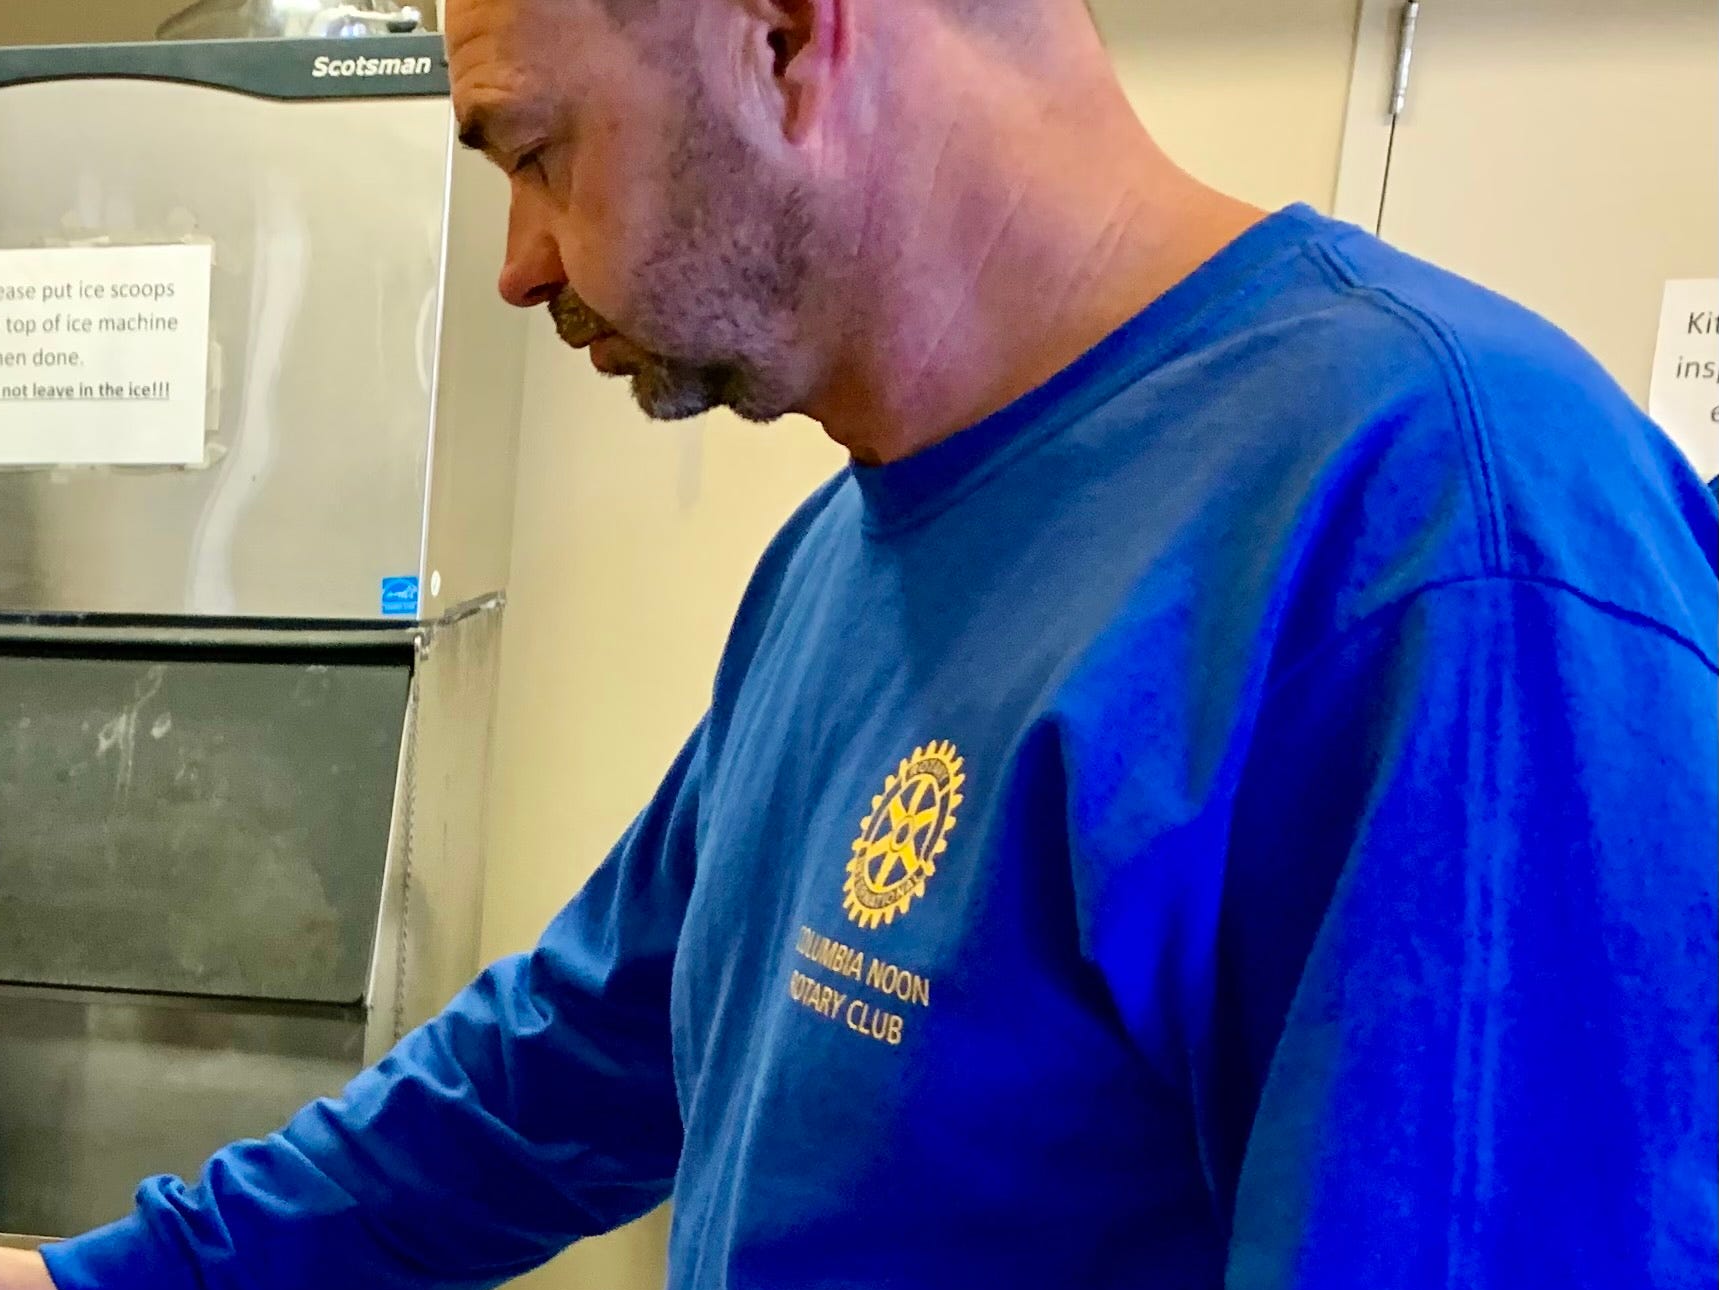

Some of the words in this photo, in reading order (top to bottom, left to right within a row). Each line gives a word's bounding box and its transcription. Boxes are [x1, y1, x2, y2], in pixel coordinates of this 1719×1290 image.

[311, 56, 432, 77] Scotsman
[42, 282, 72, 302] put
[79, 281, 104, 299] ice
[111, 281, 175, 302] scoops
[6, 316, 37, 336] top
[42, 314, 61, 333] of
[67, 314, 92, 332] ice
[98, 313, 178, 332] machine
[32, 348, 85, 366] done.
[1676, 355, 1719, 384] ins
[2, 383, 28, 398] not
[32, 383, 74, 398] leave
[79, 382, 93, 398] in
[99, 382, 124, 398] the
[128, 381, 170, 398] ice!!!
[795, 925, 864, 981] OLUMBIA
[866, 958, 930, 1007] NOON
[790, 969, 847, 1019] OTARY
[846, 1000, 904, 1045] CLUB
